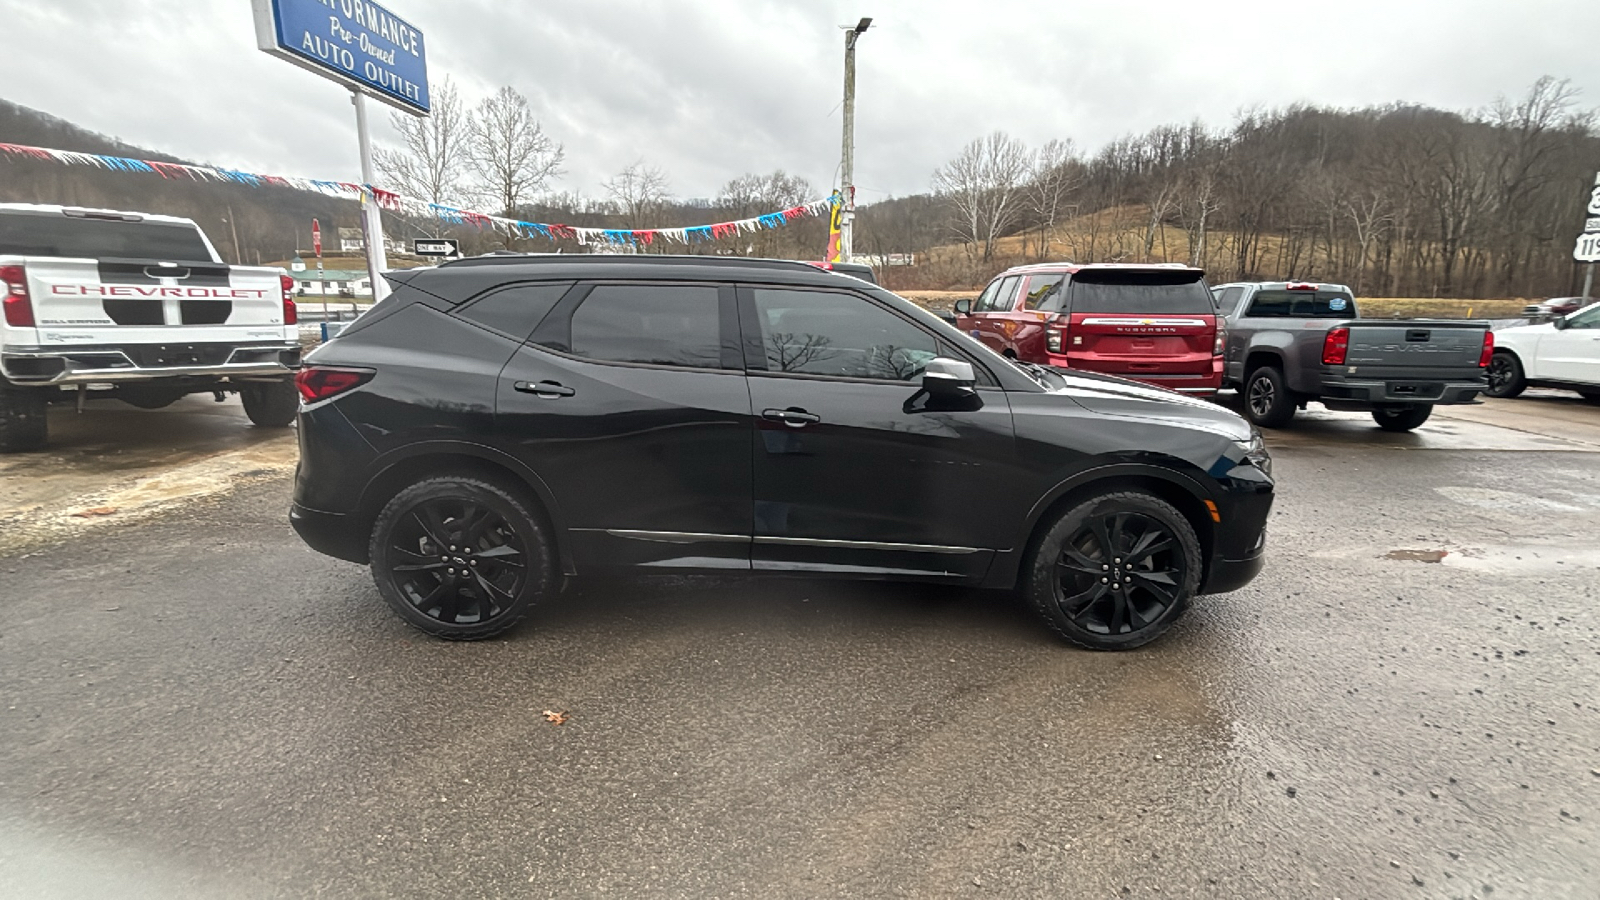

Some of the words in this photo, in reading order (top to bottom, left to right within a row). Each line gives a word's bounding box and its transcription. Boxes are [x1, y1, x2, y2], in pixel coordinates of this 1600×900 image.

[318, 0, 419, 57] ORMANCE
[329, 16, 395, 66] Pre-Owned
[302, 31, 354, 71] AUTO
[365, 61, 419, 101] OUTLET
[52, 284, 269, 299] CHEVROLET
